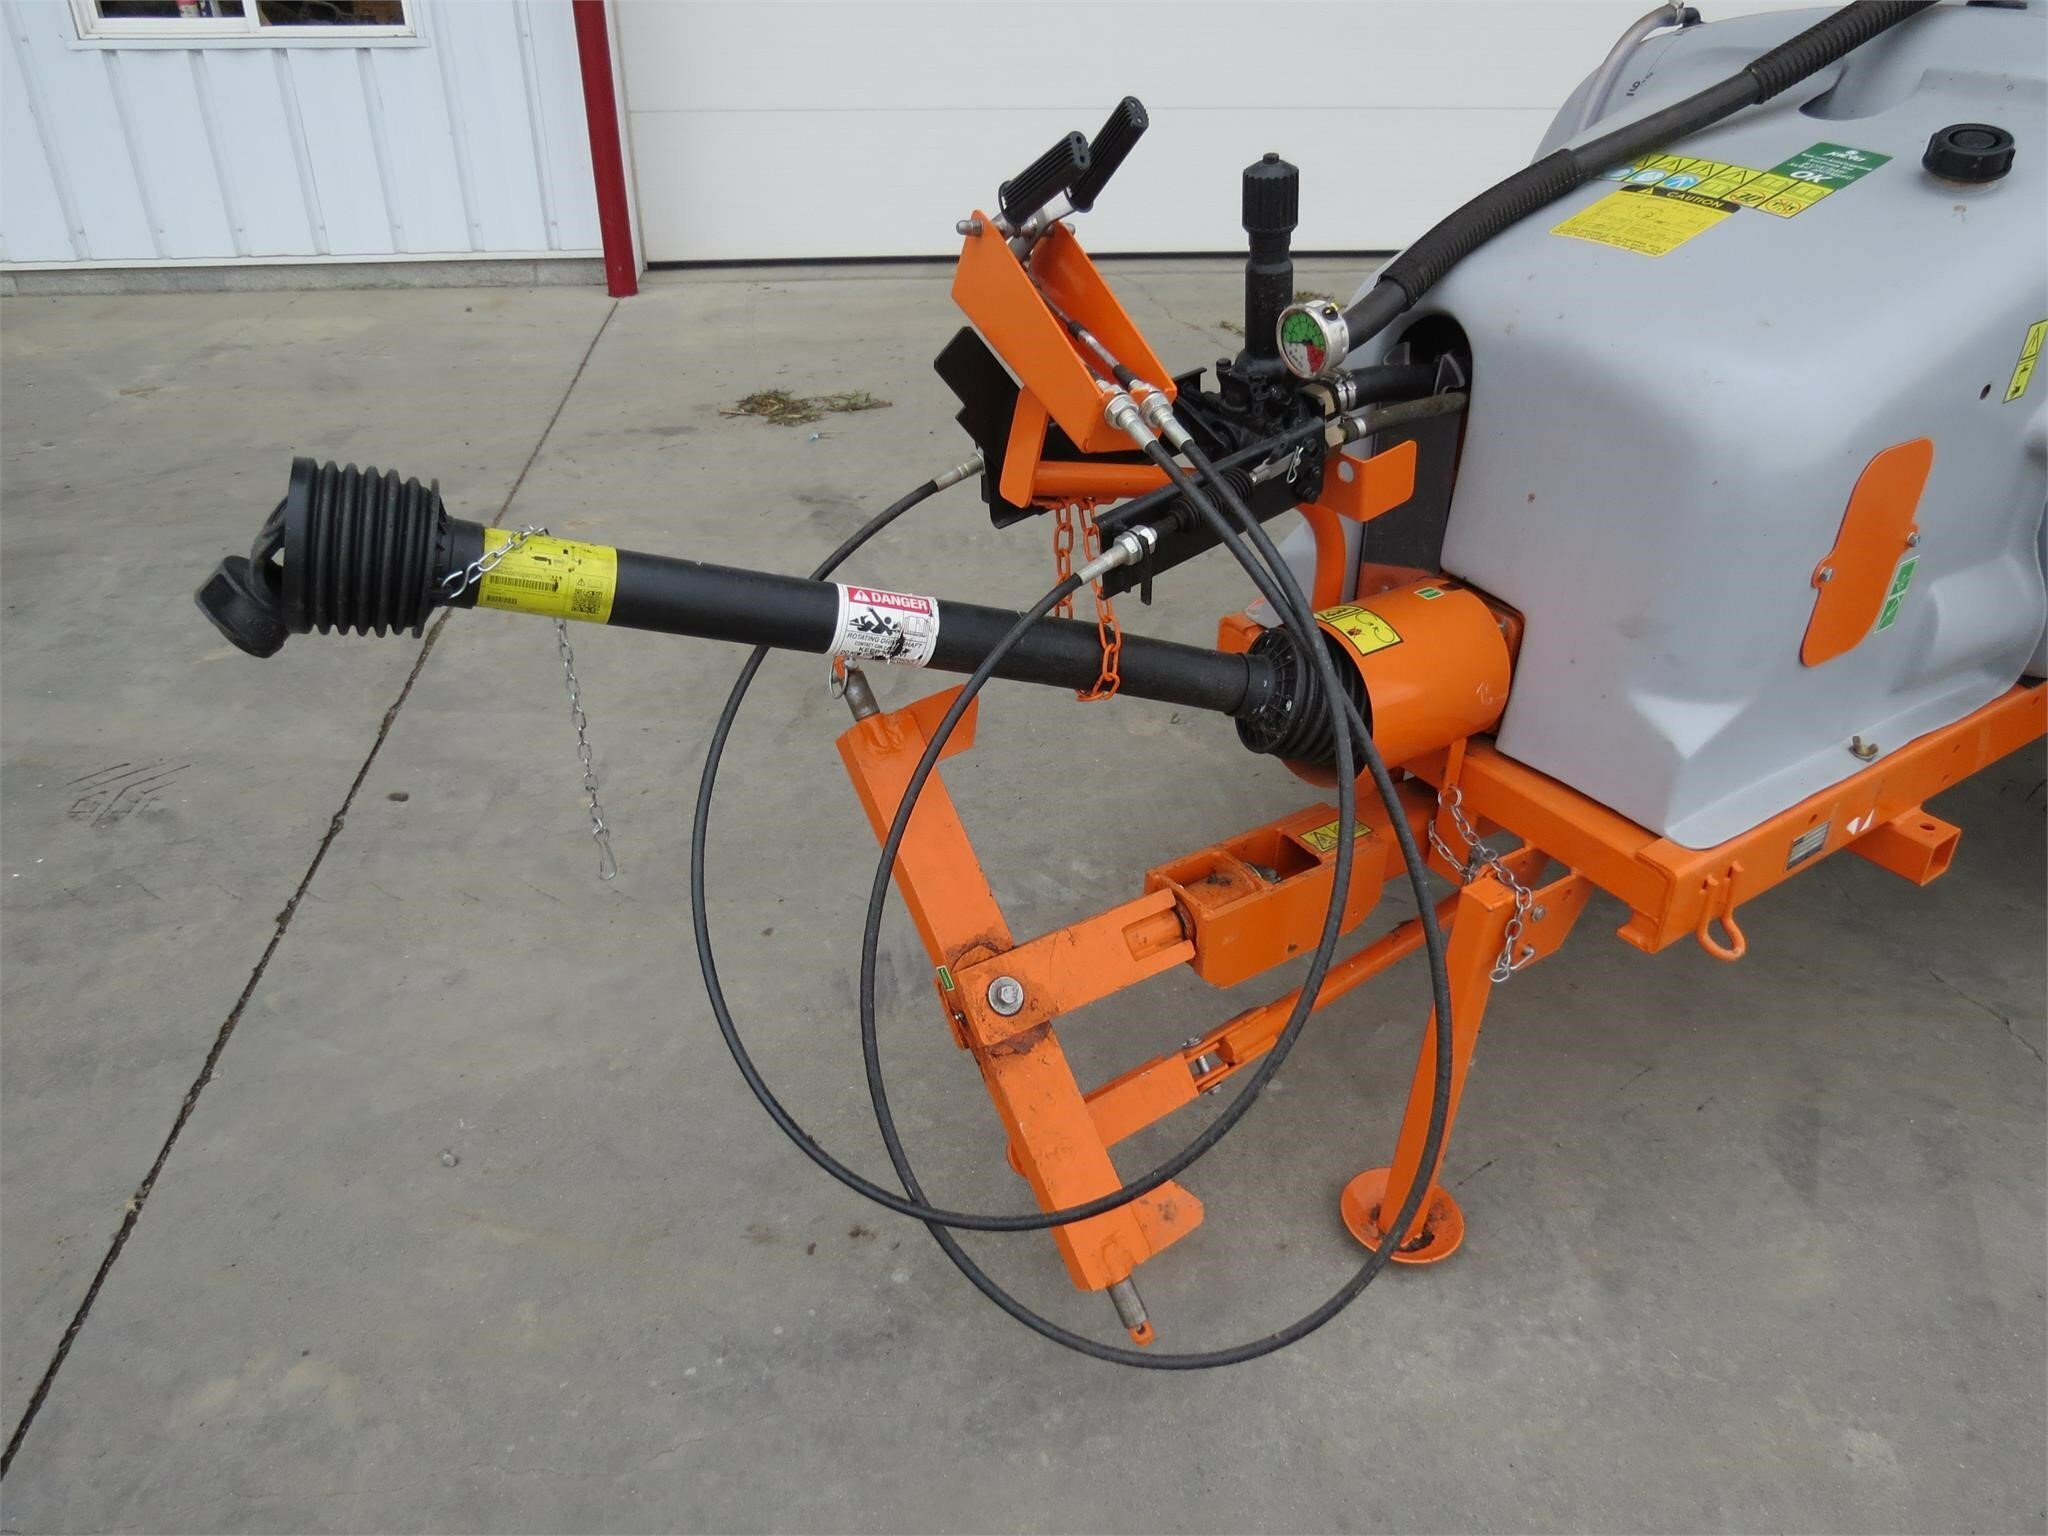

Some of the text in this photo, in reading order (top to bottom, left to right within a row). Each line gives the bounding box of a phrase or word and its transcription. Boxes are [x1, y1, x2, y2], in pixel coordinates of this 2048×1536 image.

[1790, 170, 1833, 183] OK
[1666, 191, 1724, 208] CAUTION
[871, 592, 928, 610] DANGER
[847, 632, 879, 643] ROTATING
